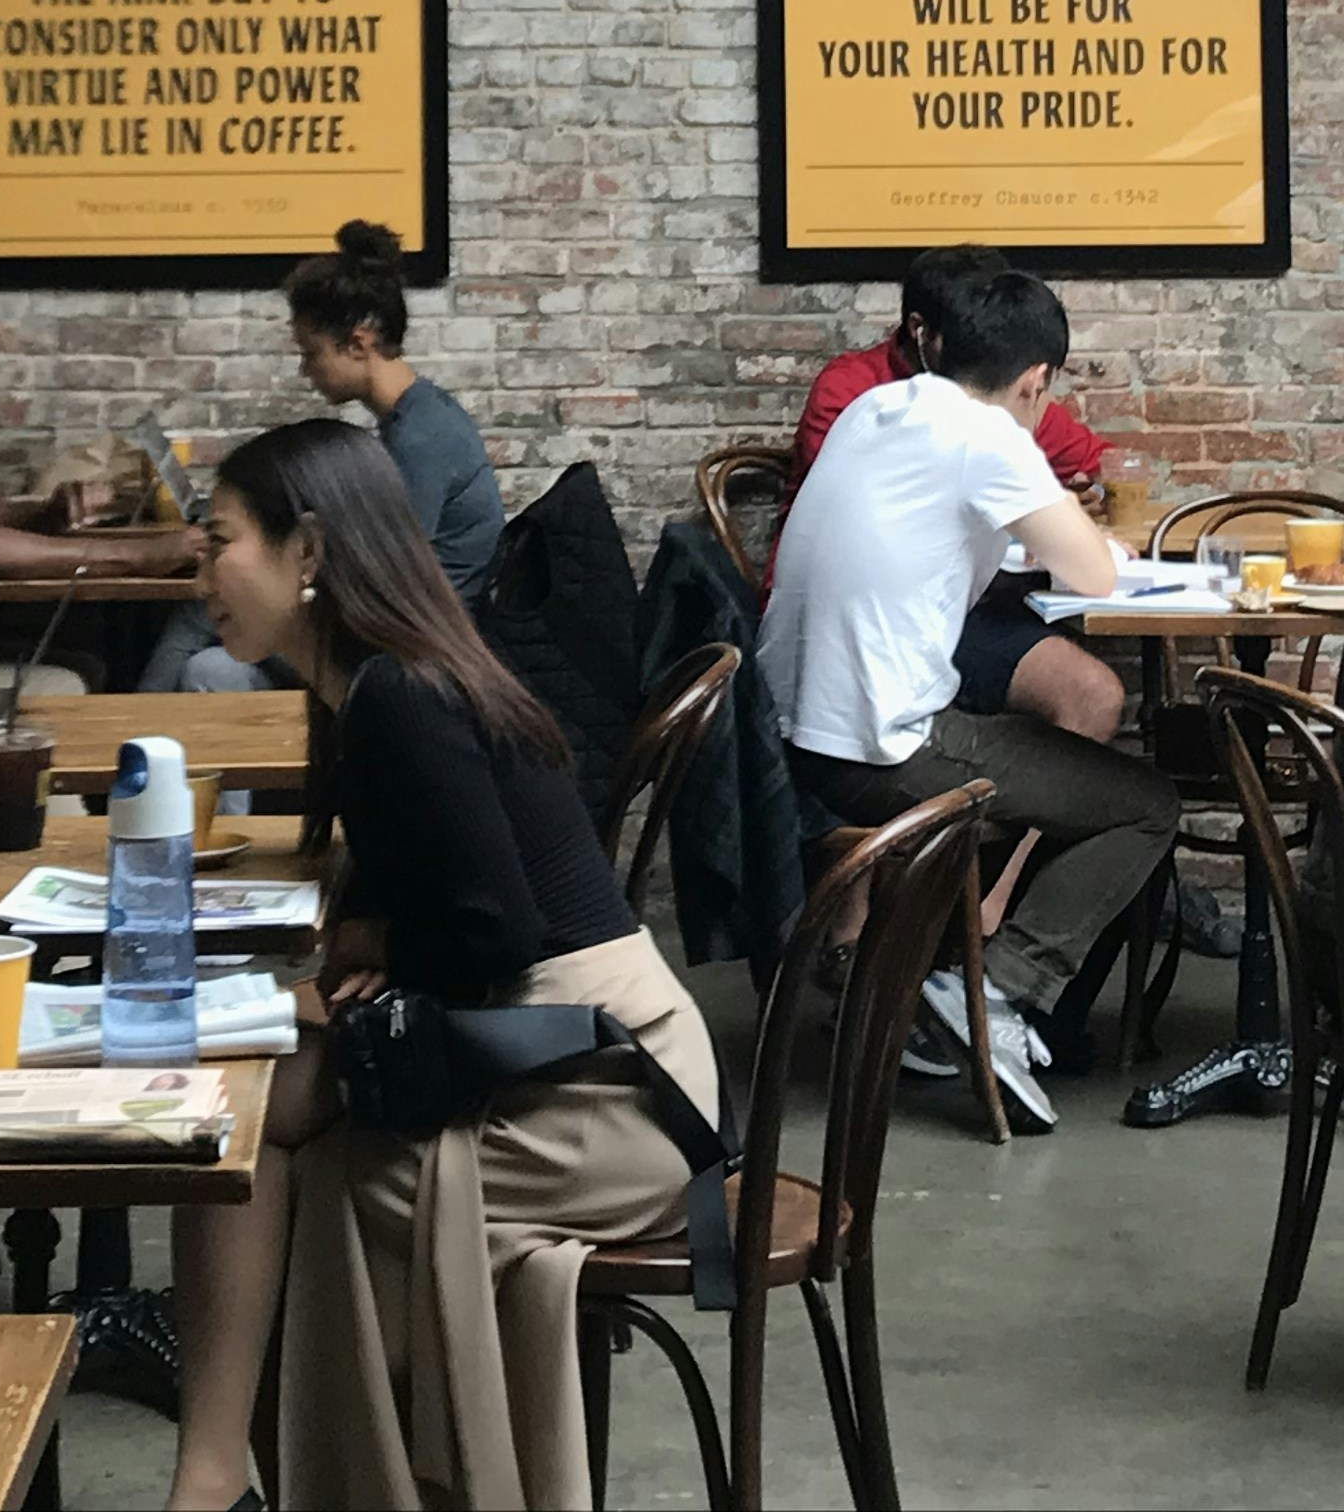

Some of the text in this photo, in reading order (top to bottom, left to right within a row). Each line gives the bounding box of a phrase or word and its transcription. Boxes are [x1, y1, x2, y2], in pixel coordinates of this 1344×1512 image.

[174, 17, 265, 56] ONLY
[277, 15, 383, 54] WHAT
[817, 37, 1229, 79] YOUR HEALTH AND FOR
[1, 65, 362, 108] VIRTUE AND POWER
[911, 90, 1134, 130] YOUR PRIDE.
[6, 115, 356, 157] MAY LIE IN COFFEE.
[889, 190, 984, 208] Geoffrey
[995, 189, 1078, 206] Chaucer
